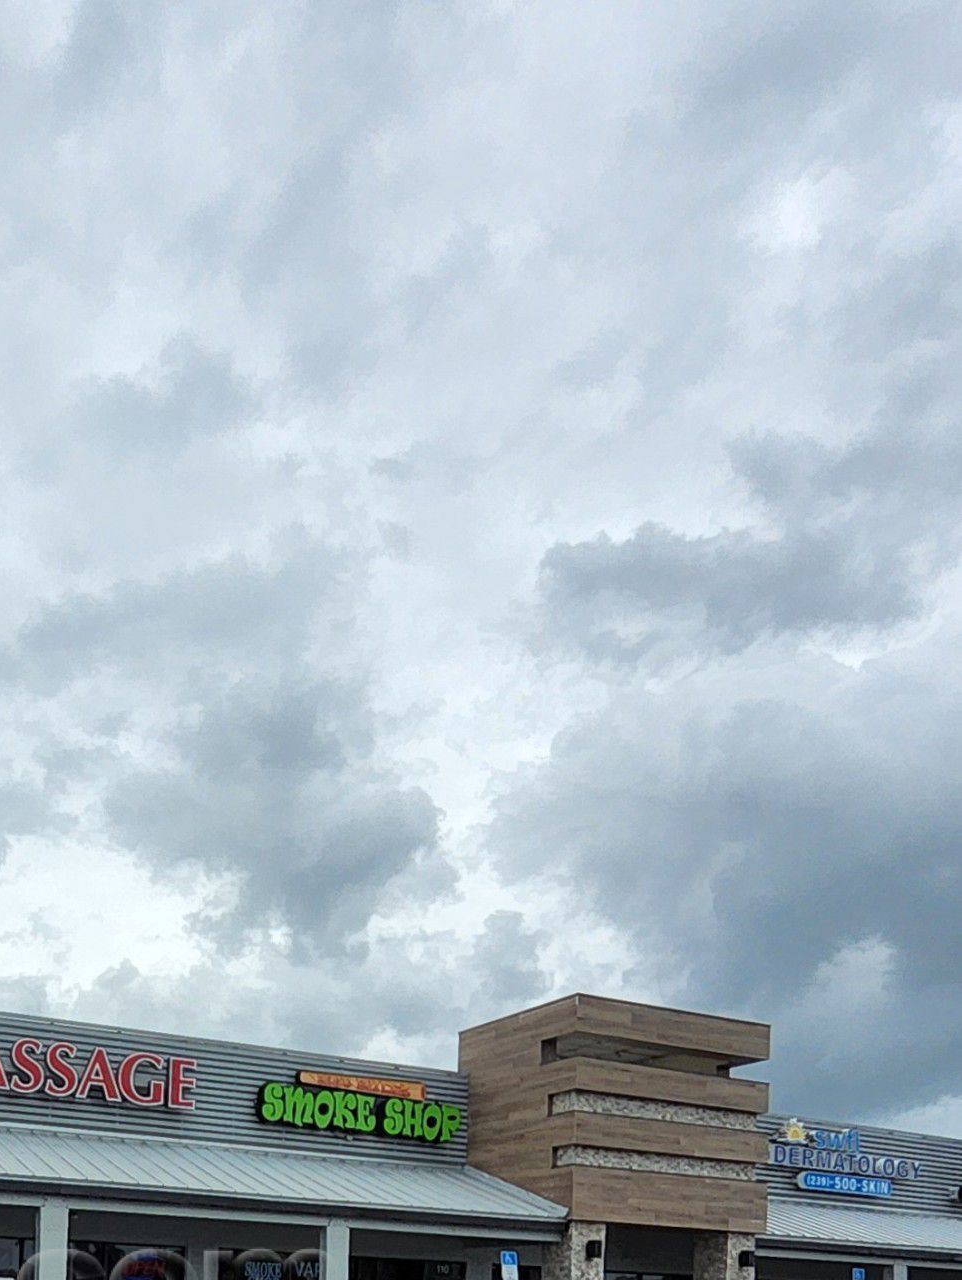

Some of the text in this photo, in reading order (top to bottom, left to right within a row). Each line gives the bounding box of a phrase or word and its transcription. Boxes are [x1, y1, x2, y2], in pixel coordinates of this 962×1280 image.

[261, 1081, 377, 1133] SMOKE
[382, 1097, 462, 1143] SHOP
[772, 1145, 923, 1179] DERMATOLOGY
[244, 1260, 282, 1278] SMOKE
